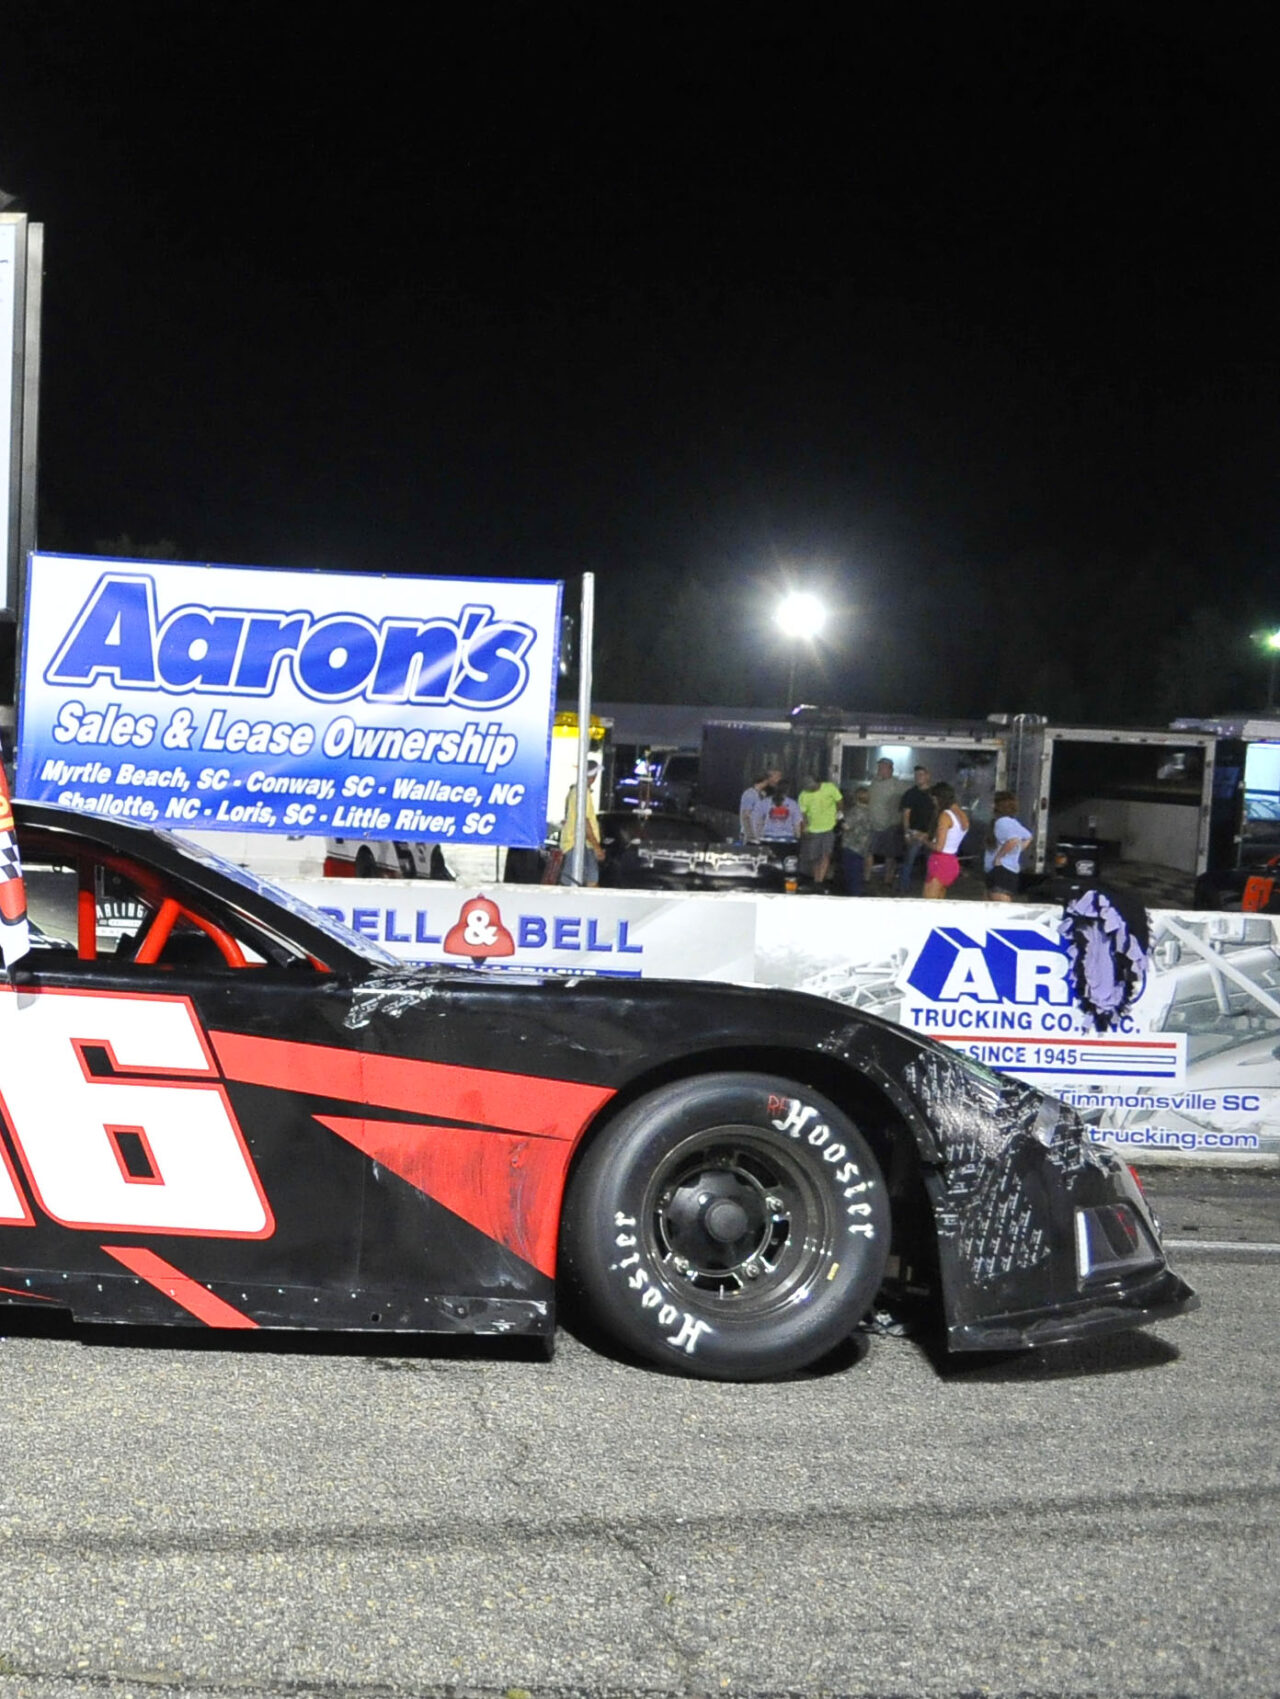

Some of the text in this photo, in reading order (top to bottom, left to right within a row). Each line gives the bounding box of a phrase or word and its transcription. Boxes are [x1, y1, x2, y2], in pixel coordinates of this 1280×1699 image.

[43, 571, 537, 712] Aaron's
[52, 701, 154, 749] Sales
[162, 707, 198, 752] &
[201, 709, 316, 759] Lease
[322, 715, 518, 774] Ownership
[40, 759, 112, 786] Myrtle
[115, 763, 190, 792] Beach,
[196, 769, 230, 790] SC
[246, 771, 335, 800] Conway,
[341, 775, 375, 799] SC
[392, 778, 482, 807] Wallace,
[488, 783, 525, 806] NC
[165, 797, 201, 819] NC
[216, 800, 276, 827] Loris,
[283, 802, 317, 826] SC
[331, 805, 391, 831] Little
[394, 809, 456, 836] River,
[462, 812, 497, 836] SC
[95, 903, 145, 918] ARLING
[463, 910, 498, 946] &
[518, 915, 643, 953] BELL
[910, 1008, 1033, 1030] TRUCKING
[969, 1045, 1077, 1065] SINCE 1945
[1223, 1094, 1261, 1112] SC
[1089, 1125, 1258, 1149] trucking.com
[771, 1098, 875, 1239] Hoosier
[609, 1211, 714, 1353] Hoosier
